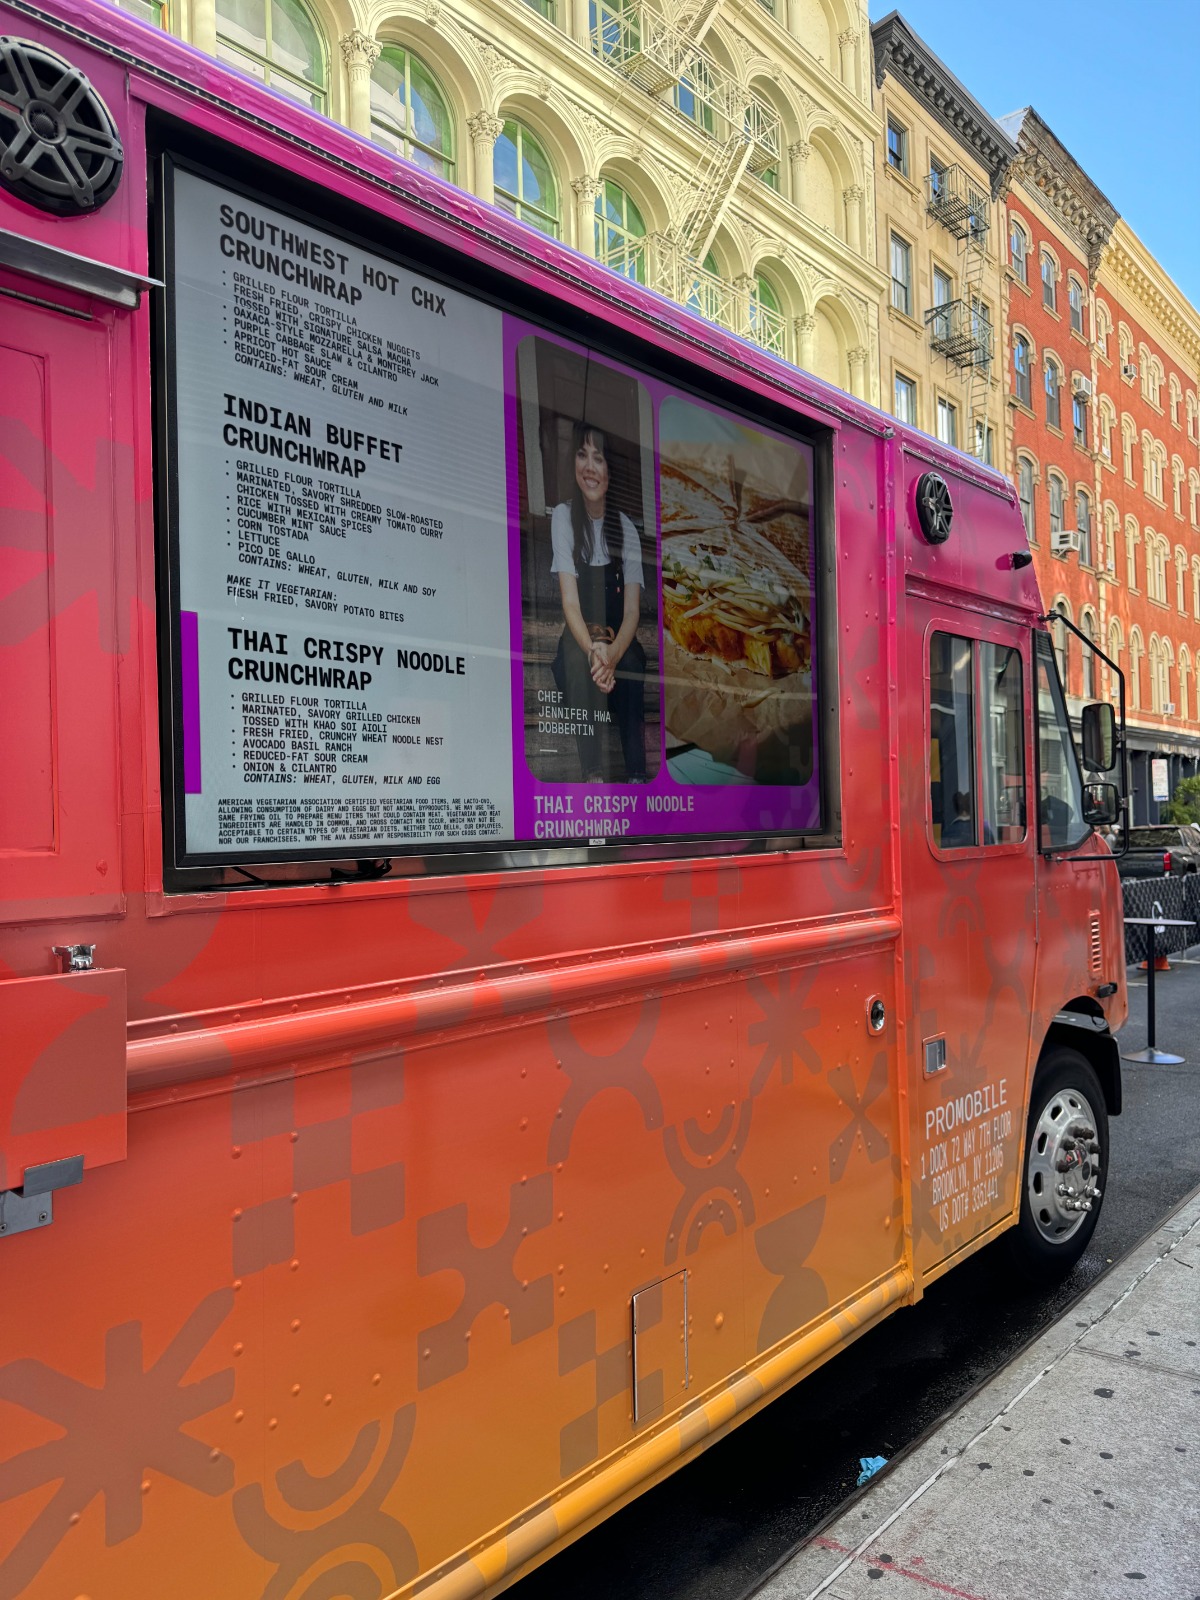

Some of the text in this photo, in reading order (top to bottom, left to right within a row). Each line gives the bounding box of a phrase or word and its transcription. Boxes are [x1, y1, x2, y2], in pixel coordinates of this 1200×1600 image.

[220, 204, 446, 316] SOUTHWEST HOT CHX
[220, 234, 362, 306] CRUNCHWRAP
[233, 271, 357, 326] GRILLED FLOUR TORTILLA
[233, 294, 411, 367] TOSSED WITH SIGNATURE SALSA MACHA
[234, 283, 420, 360] FRESH FRIED, CRISPY CHICKEN NUGGETS
[233, 306, 438, 386] OAXACA-STYLE MOZZARELLA & MONTEREY JACK
[234, 317, 397, 382] PURPLE CABBAGE SLAW & CILANTRO
[234, 329, 331, 370] APRICOT HOT SAUCE
[234, 340, 358, 390] REDUCED-FAT SOUR CREAM
[234, 352, 408, 416] CONTAINS: WHEAT, GLUTEN AND MILK
[224, 393, 402, 463] INDIAN BUFFET
[223, 423, 366, 478] CRUNCHWRAP
[236, 460, 361, 499] GRILLED FLOUR TORTILLA
[236, 471, 443, 529] MARINATED, SAVORY SHREDDED SLOW-ROASTED
[236, 483, 443, 539] CHICKEN TOSSED WITH CREAMY TOMATO CURRY
[237, 495, 372, 533] RICE WITH MEXICAN SPICES
[237, 506, 346, 538] CUCUMBER MINT SAUCE
[237, 518, 309, 541] CORN TOSTADA
[238, 529, 280, 547] LETTUCE
[238, 541, 315, 564] PICO DE GALLO
[226, 574, 336, 601] MAKE IT VEGETARIAN:
[238, 552, 436, 597] CONTAINS: WHEAT, GLUTEN, MILK AND SOY
[227, 585, 404, 622] FRESH FRIED, SAVORY POTATO BITES
[227, 627, 465, 675] THAI CRISPY NOODLE
[228, 657, 372, 690] CRUNCHWRAP
[241, 692, 367, 710] GRILLED FLOUR TORTILLA
[242, 703, 420, 724] MARINATED, SAVORY GRILLED CHICKEN
[538, 690, 563, 703] CHEF
[538, 706, 611, 722] JENNIFER HWA
[242, 715, 387, 733] TOSSED WITH KHAO SOI AIOLI
[243, 727, 443, 745] FRESH FRIED, CRUNCHY WHEAT NOODLE NEST
[539, 722, 594, 736] DOBBERTIN
[242, 738, 352, 752] AVOCADO BASIL RANCH
[243, 749, 368, 763] REDUCED-FAT SOUR CREAM
[243, 761, 337, 773] ONION & CILANTRO
[243, 773, 440, 785] CONTAINS: WHEAT, GLUTEN, MILK AND EGG
[256, 798, 296, 806] VEGETARIAN
[534, 796, 694, 813] THAI CRISPY NOODLE
[219, 821, 265, 829] INGREDIENTS
[253, 835, 300, 843] FRANCHISEES,
[535, 819, 630, 838] CRUNCHWRAP
[926, 1079, 1007, 1140] PROMOBILE
[921, 1111, 1012, 1180] 1 DOCK 72 WAY 7TH FLOOR
[933, 1144, 1004, 1205] BROOKLYN, NY 11205
[940, 1203, 948, 1232] US
[952, 1193, 969, 1223] DOT#
